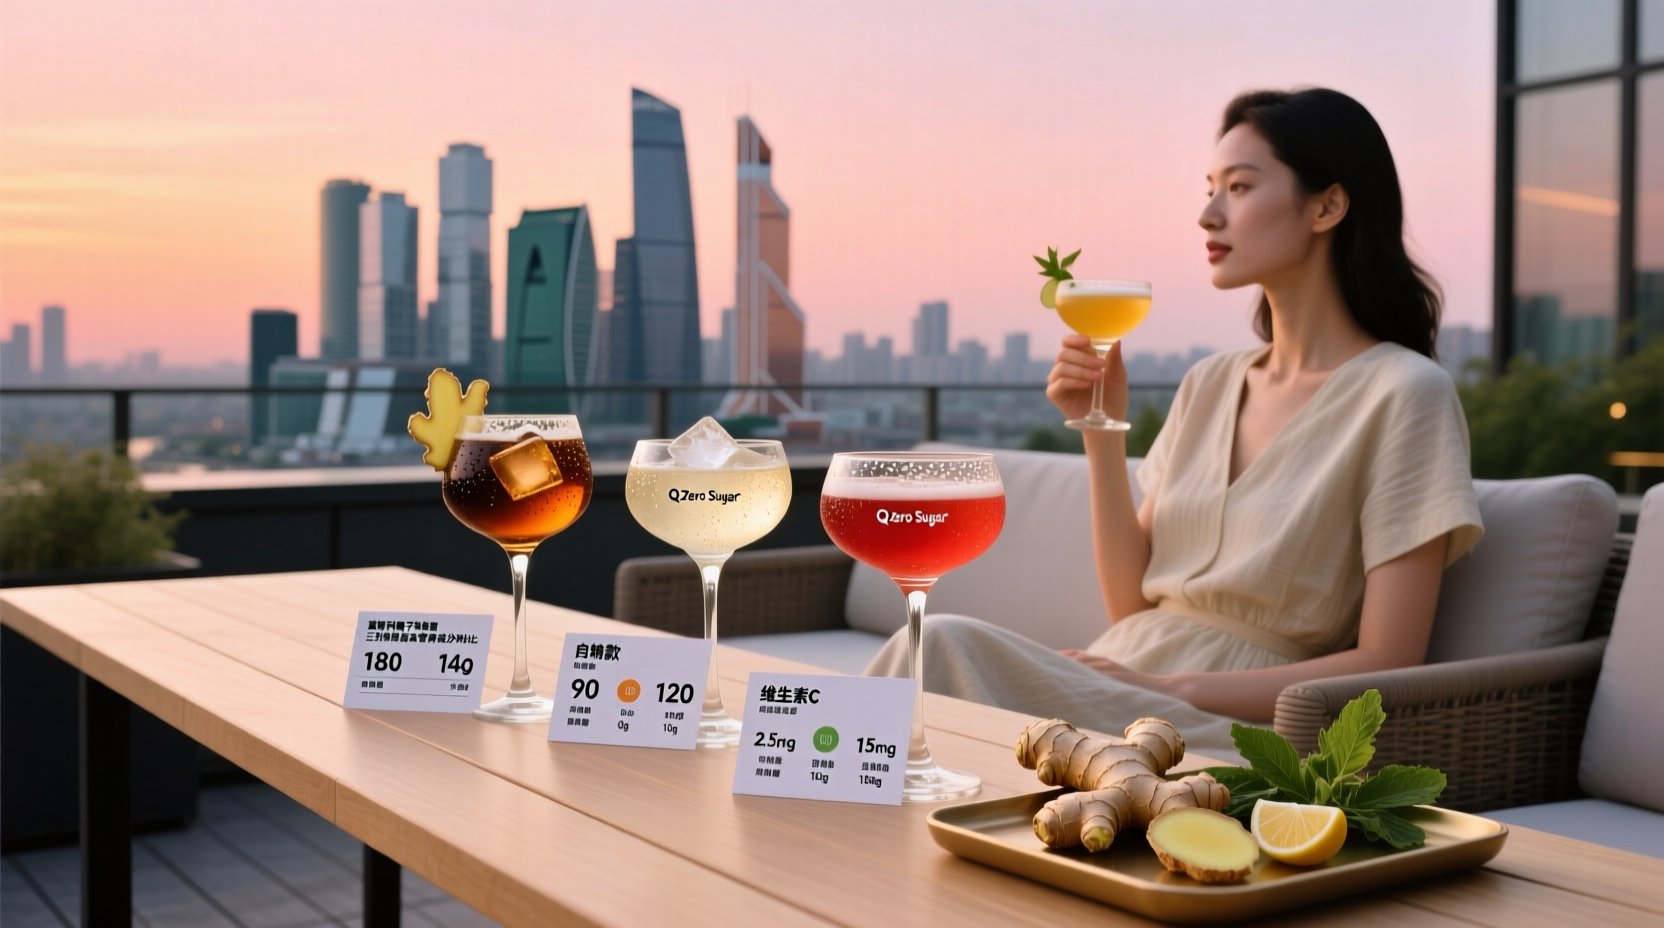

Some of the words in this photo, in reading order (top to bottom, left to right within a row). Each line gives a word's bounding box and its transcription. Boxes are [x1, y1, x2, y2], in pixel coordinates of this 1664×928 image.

[364, 651, 402, 672] 180
[571, 678, 600, 700] 90
[656, 682, 695, 704] 120
[759, 685, 820, 704] 维生素C
[617, 720, 629, 732] 0g
[856, 737, 897, 759] 15mg
